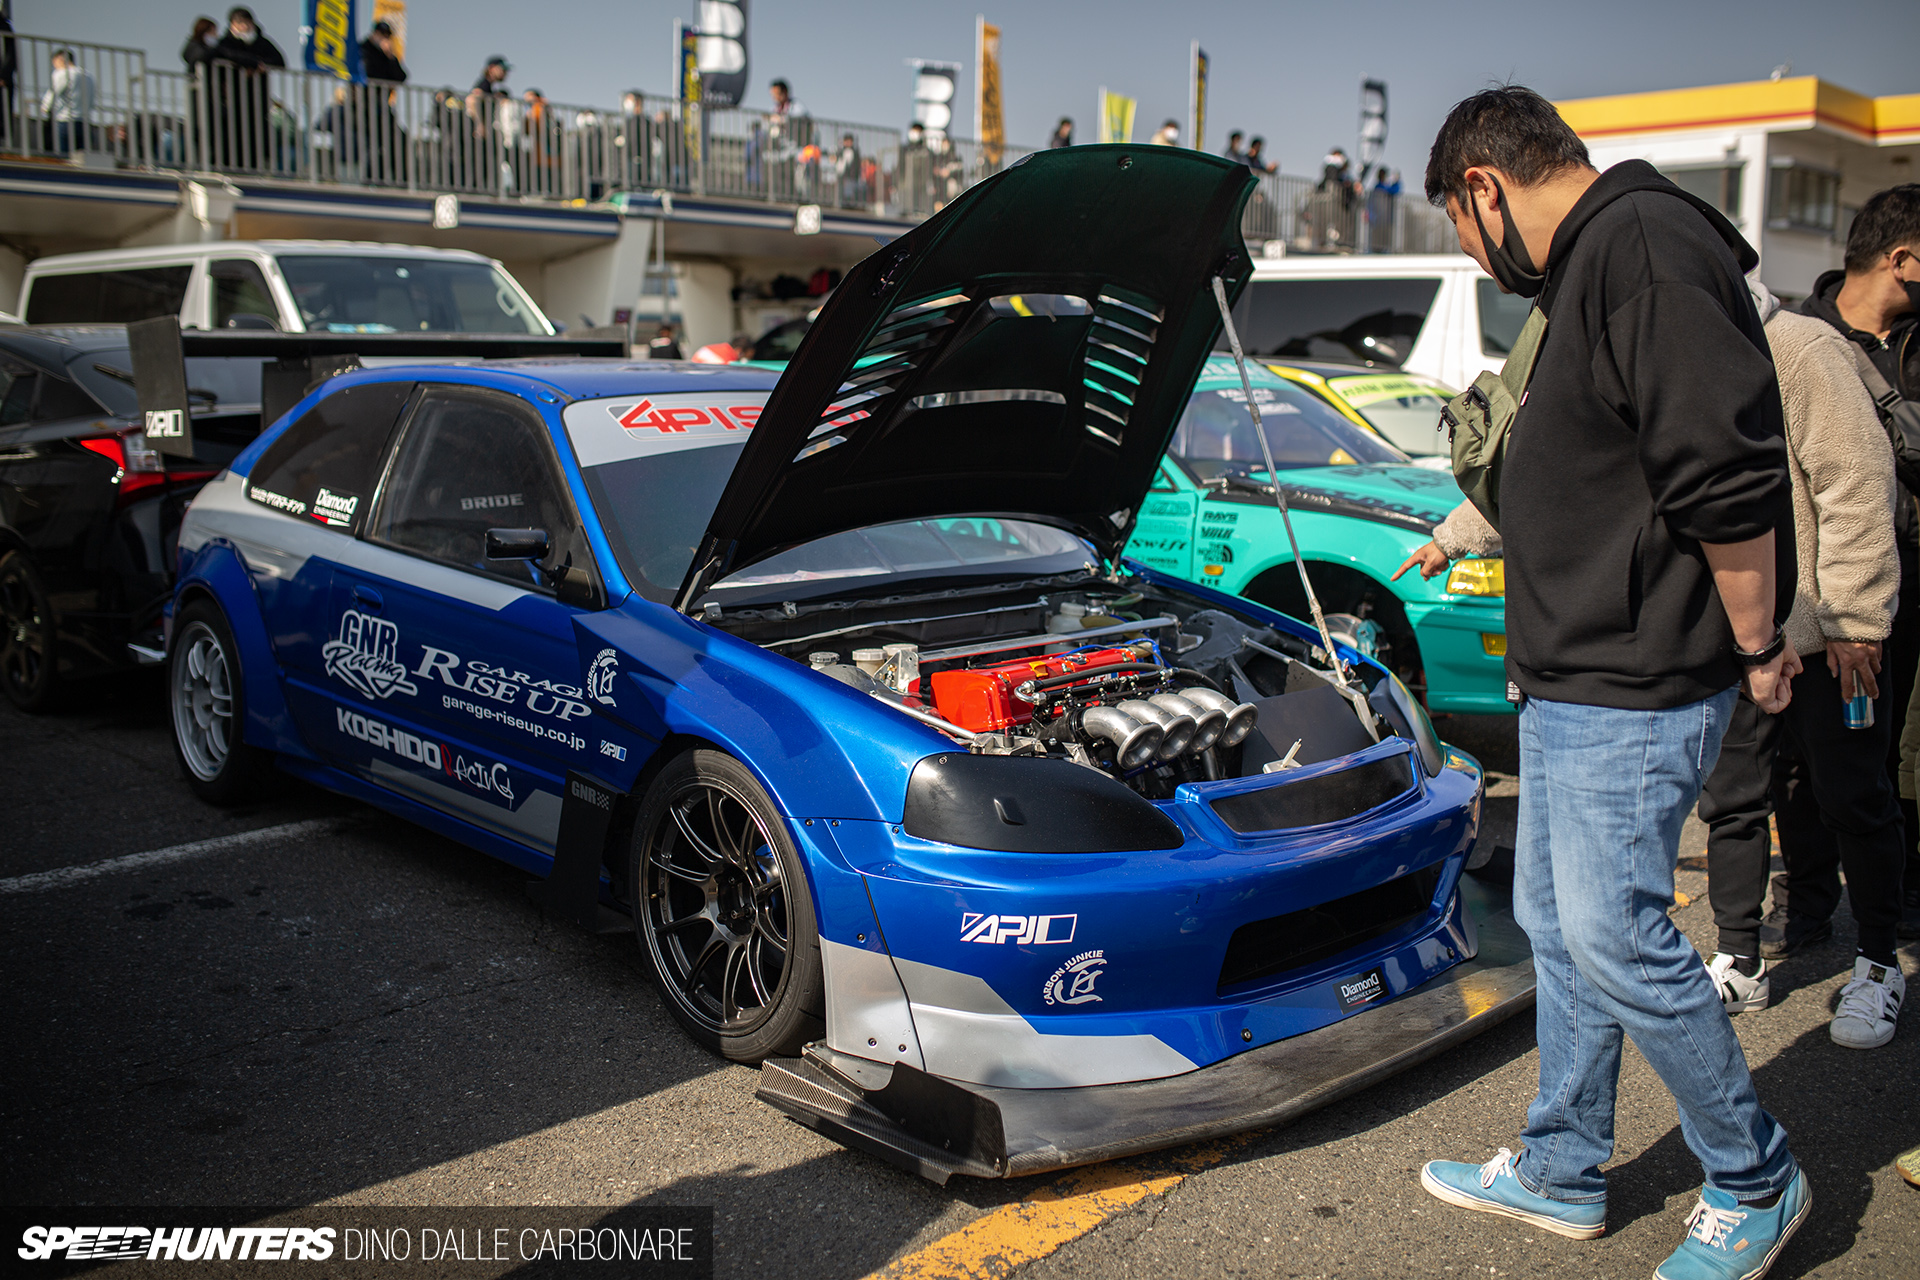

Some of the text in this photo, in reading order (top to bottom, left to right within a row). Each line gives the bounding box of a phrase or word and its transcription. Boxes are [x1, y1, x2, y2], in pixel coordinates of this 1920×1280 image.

[313, 505, 351, 522] ENGINEERING
[460, 493, 524, 510] BRIDE
[340, 609, 398, 661] GNR
[322, 640, 418, 700] Racing
[597, 648, 617, 664] JUNKIE
[526, 689, 592, 722] UP
[336, 707, 442, 770] KOSHIDO
[442, 694, 586, 751] garage-riseup.co.jp
[571, 780, 597, 805] GNR
[1043, 949, 1104, 1005] CARBON JUNKIE
[1346, 985, 1381, 1004] ENGINEERING
